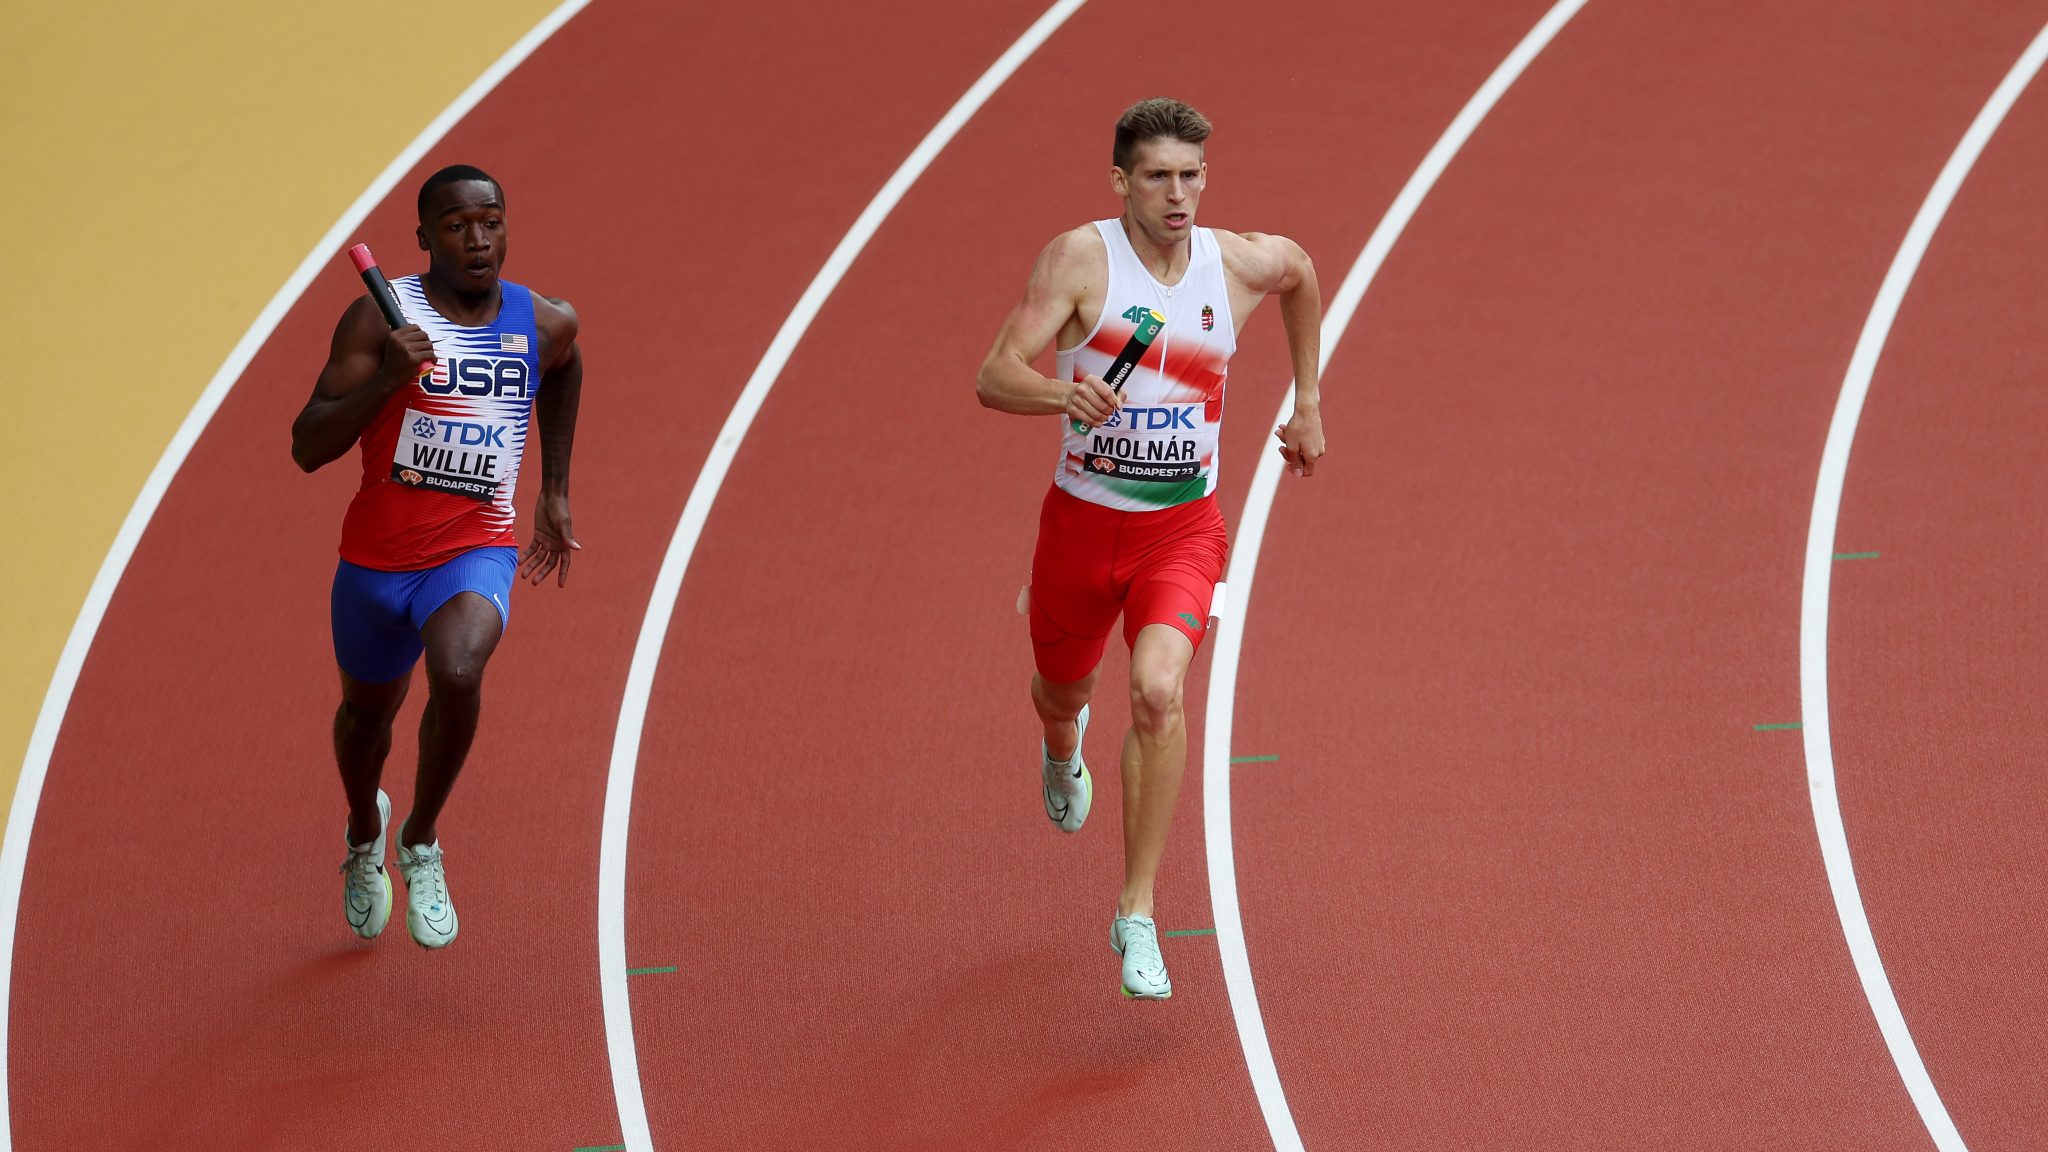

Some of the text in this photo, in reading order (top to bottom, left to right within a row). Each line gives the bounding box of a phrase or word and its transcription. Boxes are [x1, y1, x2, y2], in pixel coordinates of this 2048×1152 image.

[1147, 324, 1159, 336] 8
[418, 358, 529, 398] USA
[1111, 362, 1132, 391] MONDO
[1122, 407, 1196, 430] TDK
[438, 420, 507, 448] TDK
[1093, 434, 1196, 461] MOLNÁR
[412, 443, 498, 479] WILLIE
[1118, 464, 1194, 478] BUDAPEST 23
[426, 475, 488, 494] BUDAPEST
